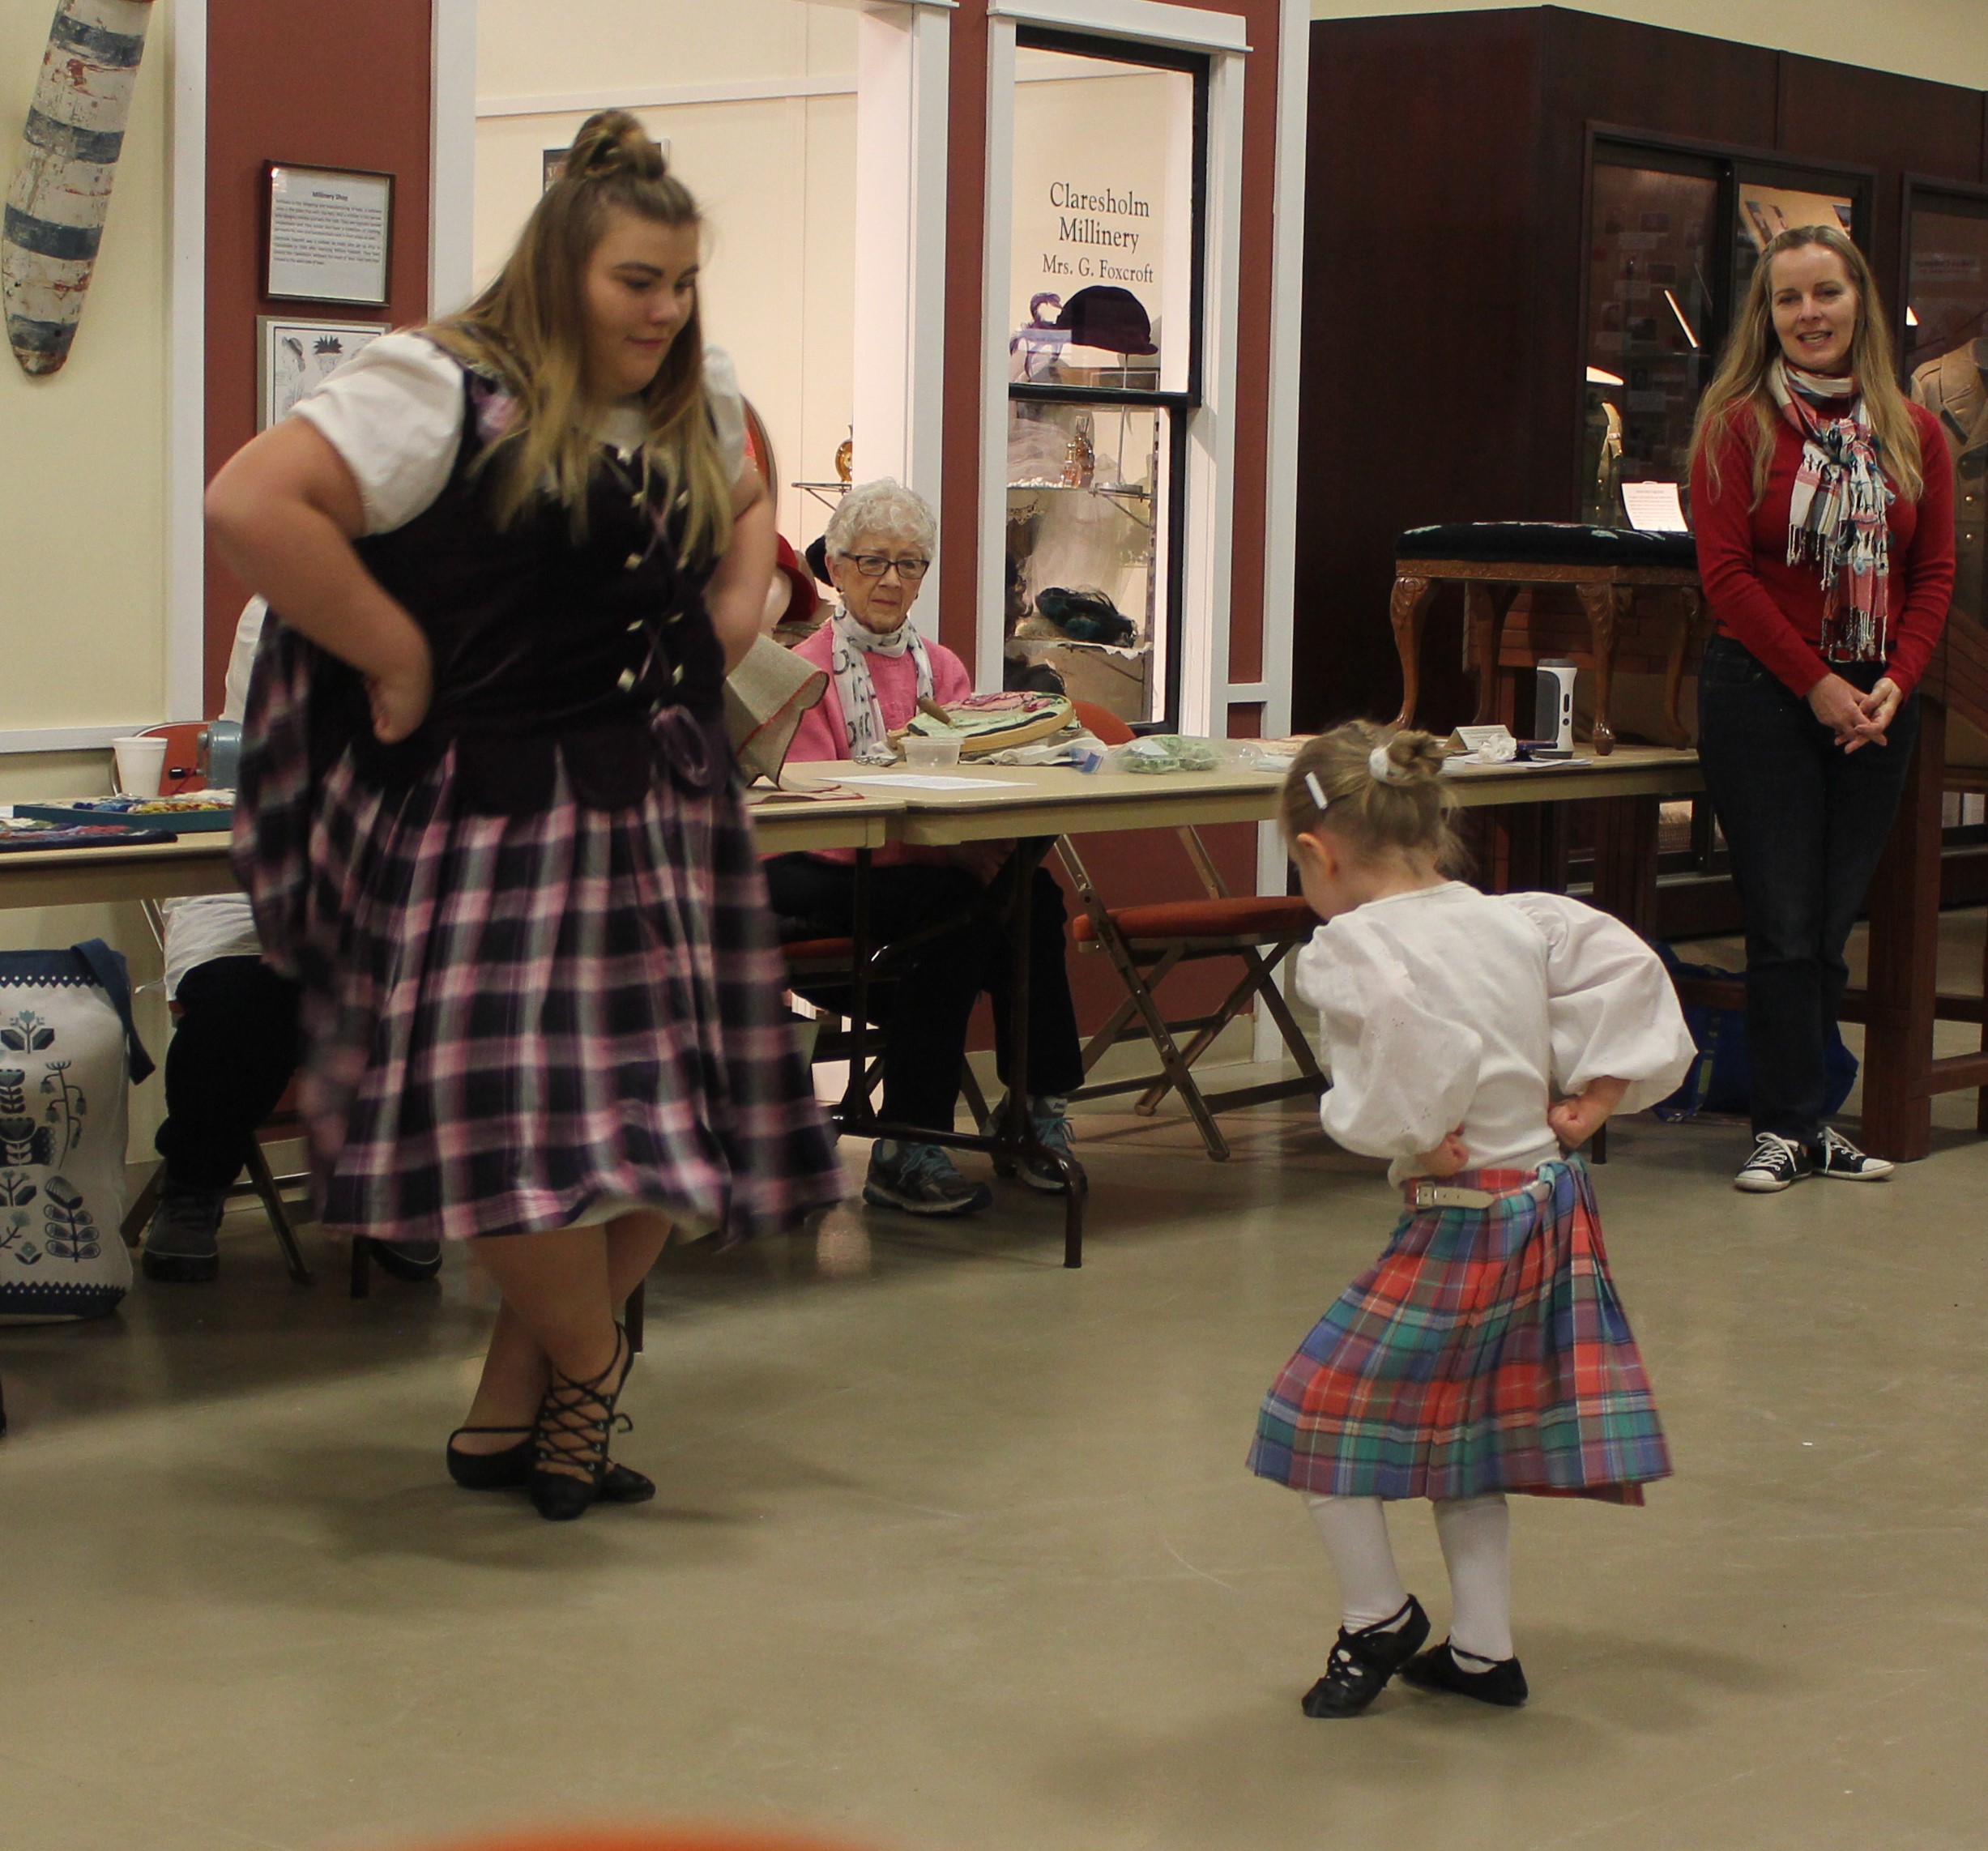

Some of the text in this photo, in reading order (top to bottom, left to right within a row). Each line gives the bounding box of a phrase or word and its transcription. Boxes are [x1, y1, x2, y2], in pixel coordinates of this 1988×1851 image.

[1050, 181, 1150, 218] Claresholm
[1059, 216, 1139, 254] Millinery
[1043, 254, 1154, 284] Mrs. G. Foxcroft
